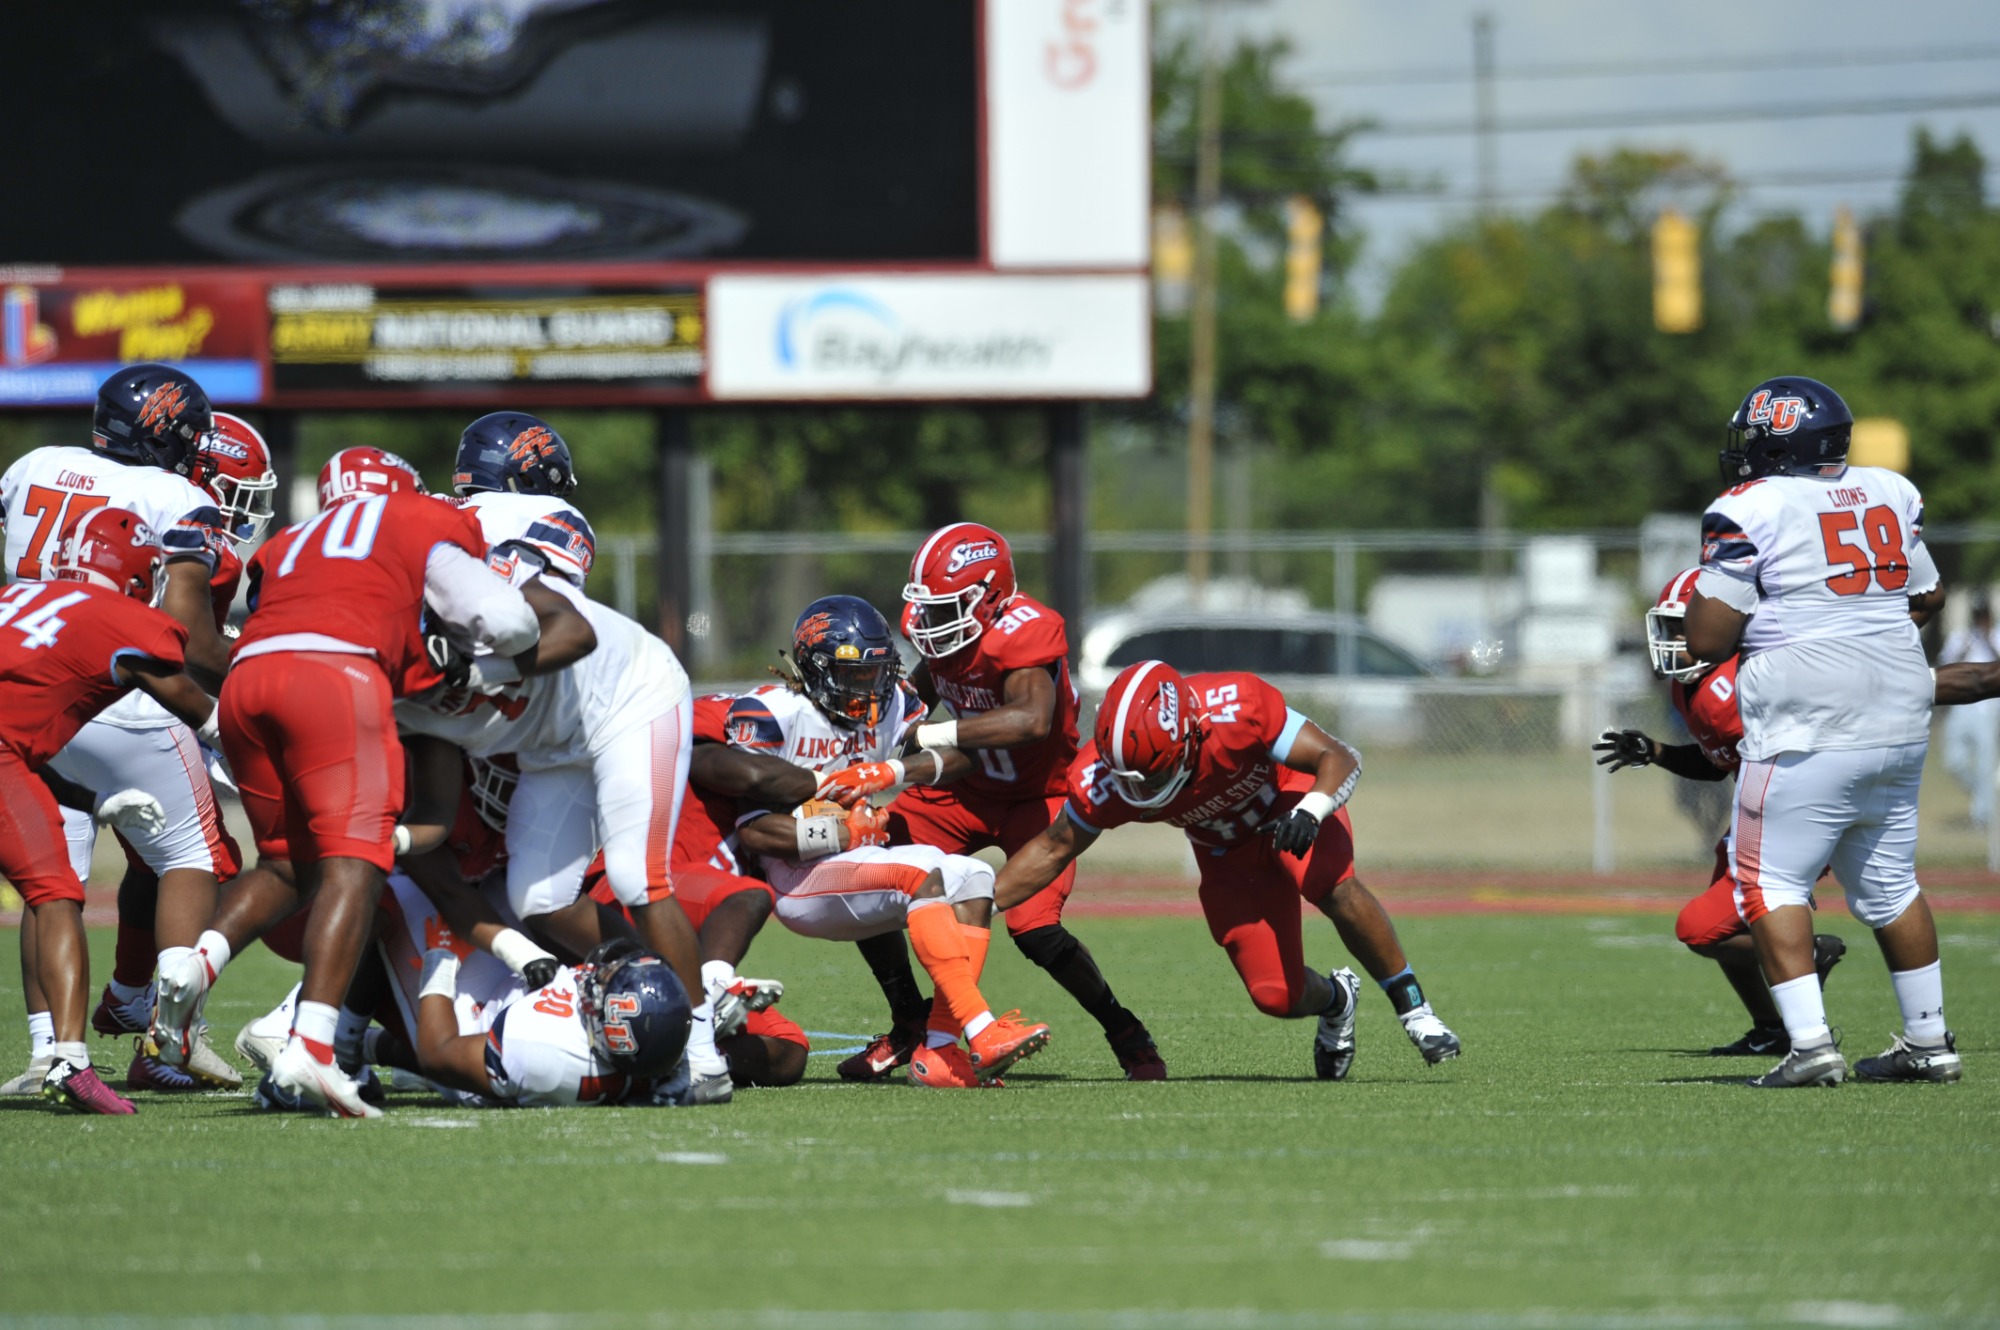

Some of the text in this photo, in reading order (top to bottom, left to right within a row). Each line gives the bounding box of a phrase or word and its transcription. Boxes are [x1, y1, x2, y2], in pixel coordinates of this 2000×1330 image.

[374, 310, 546, 349] NATIONAL
[547, 307, 674, 347] GUARD
[814, 330, 1054, 383] Bayhealth
[1747, 390, 1804, 436] LU
[56, 469, 98, 491] LIONS
[1827, 486, 1868, 508] LIONS
[62, 537, 94, 563] 34
[278, 494, 388, 577] 70
[1817, 504, 1909, 597] 58
[946, 544, 999, 573] State
[994, 605, 1040, 635] 30
[1205, 684, 1241, 723] 45
[1709, 675, 1734, 702] 0
[1158, 681, 1178, 741] State
[795, 727, 878, 759] LINCOLN
[1079, 760, 1119, 806] 45
[1168, 763, 1270, 828] LAWARE STATE
[604, 992, 642, 1054] LU
